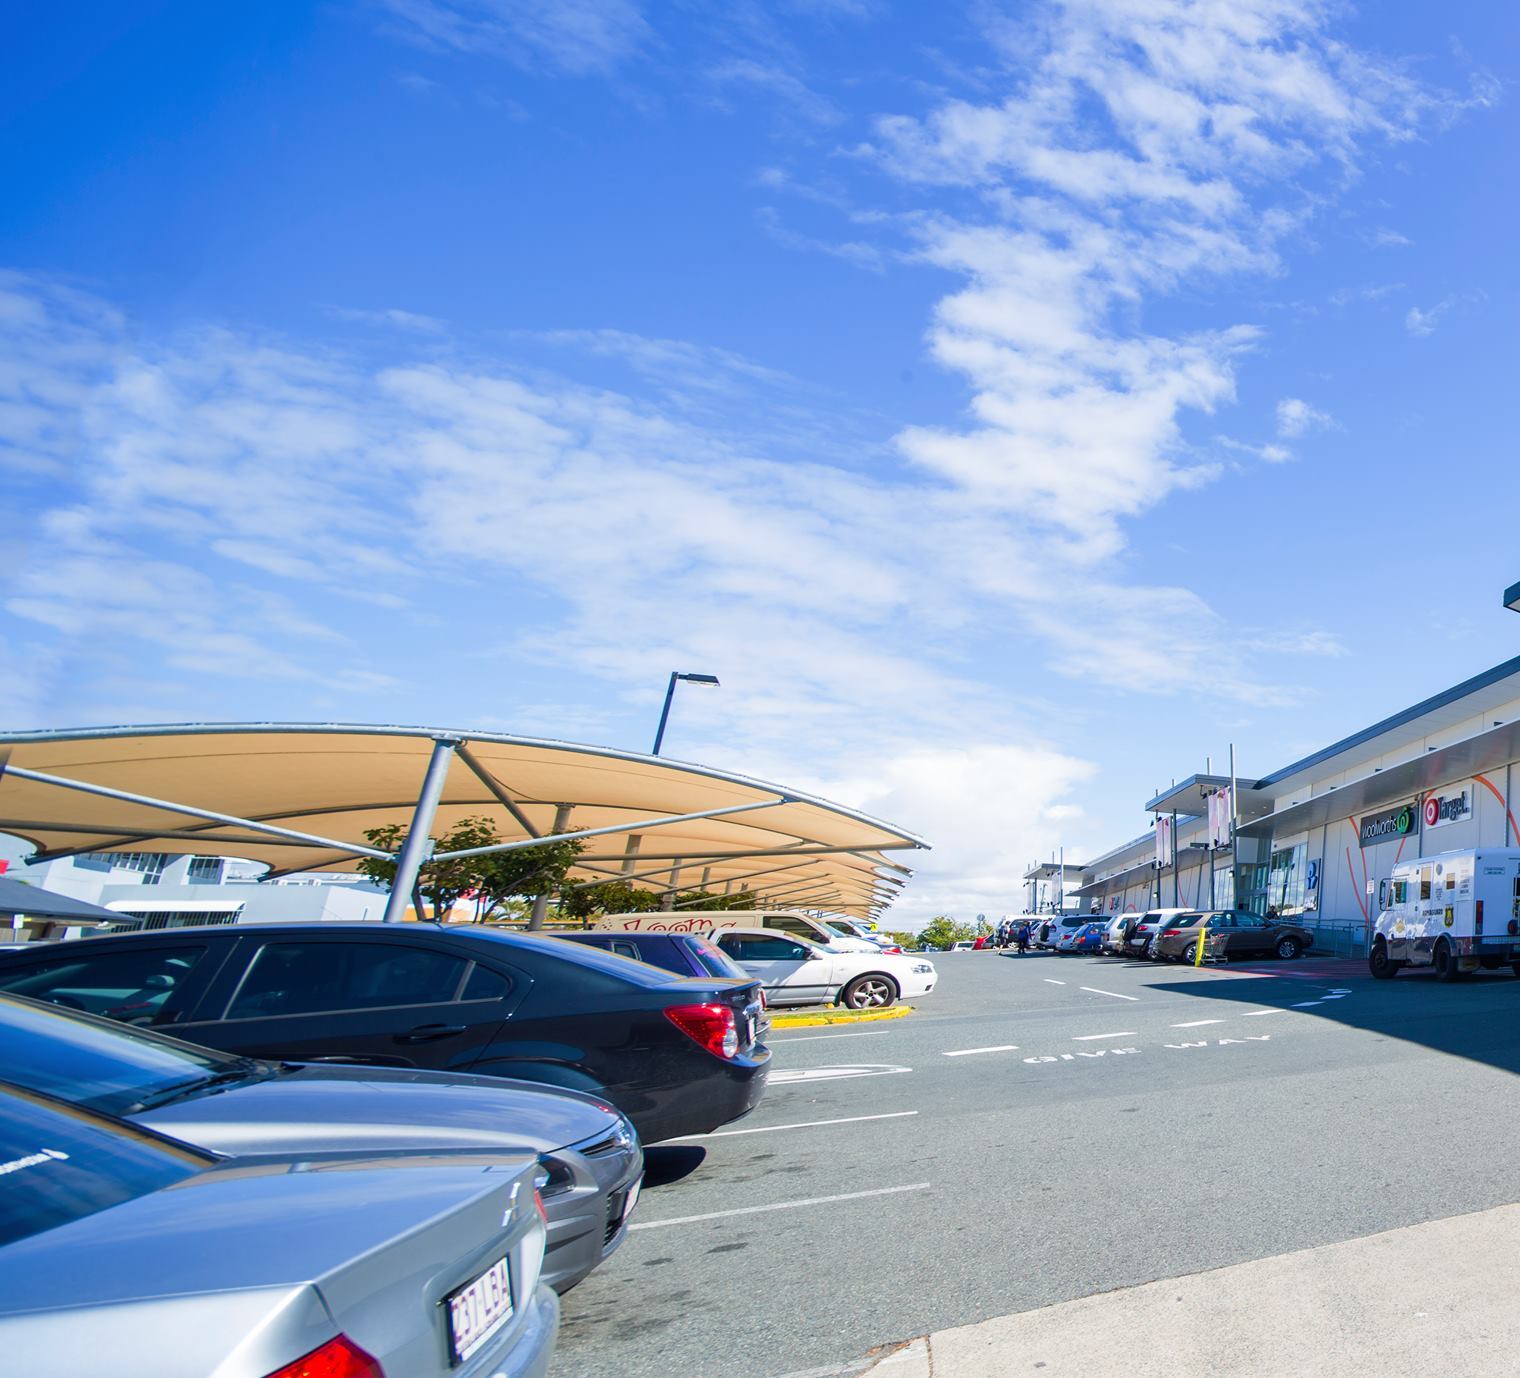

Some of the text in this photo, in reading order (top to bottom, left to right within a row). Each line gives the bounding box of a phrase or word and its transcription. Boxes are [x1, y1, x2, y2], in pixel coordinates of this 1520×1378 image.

[1362, 815, 1397, 839] woolworths
[1022, 1034, 1271, 1064] GIVE WAY
